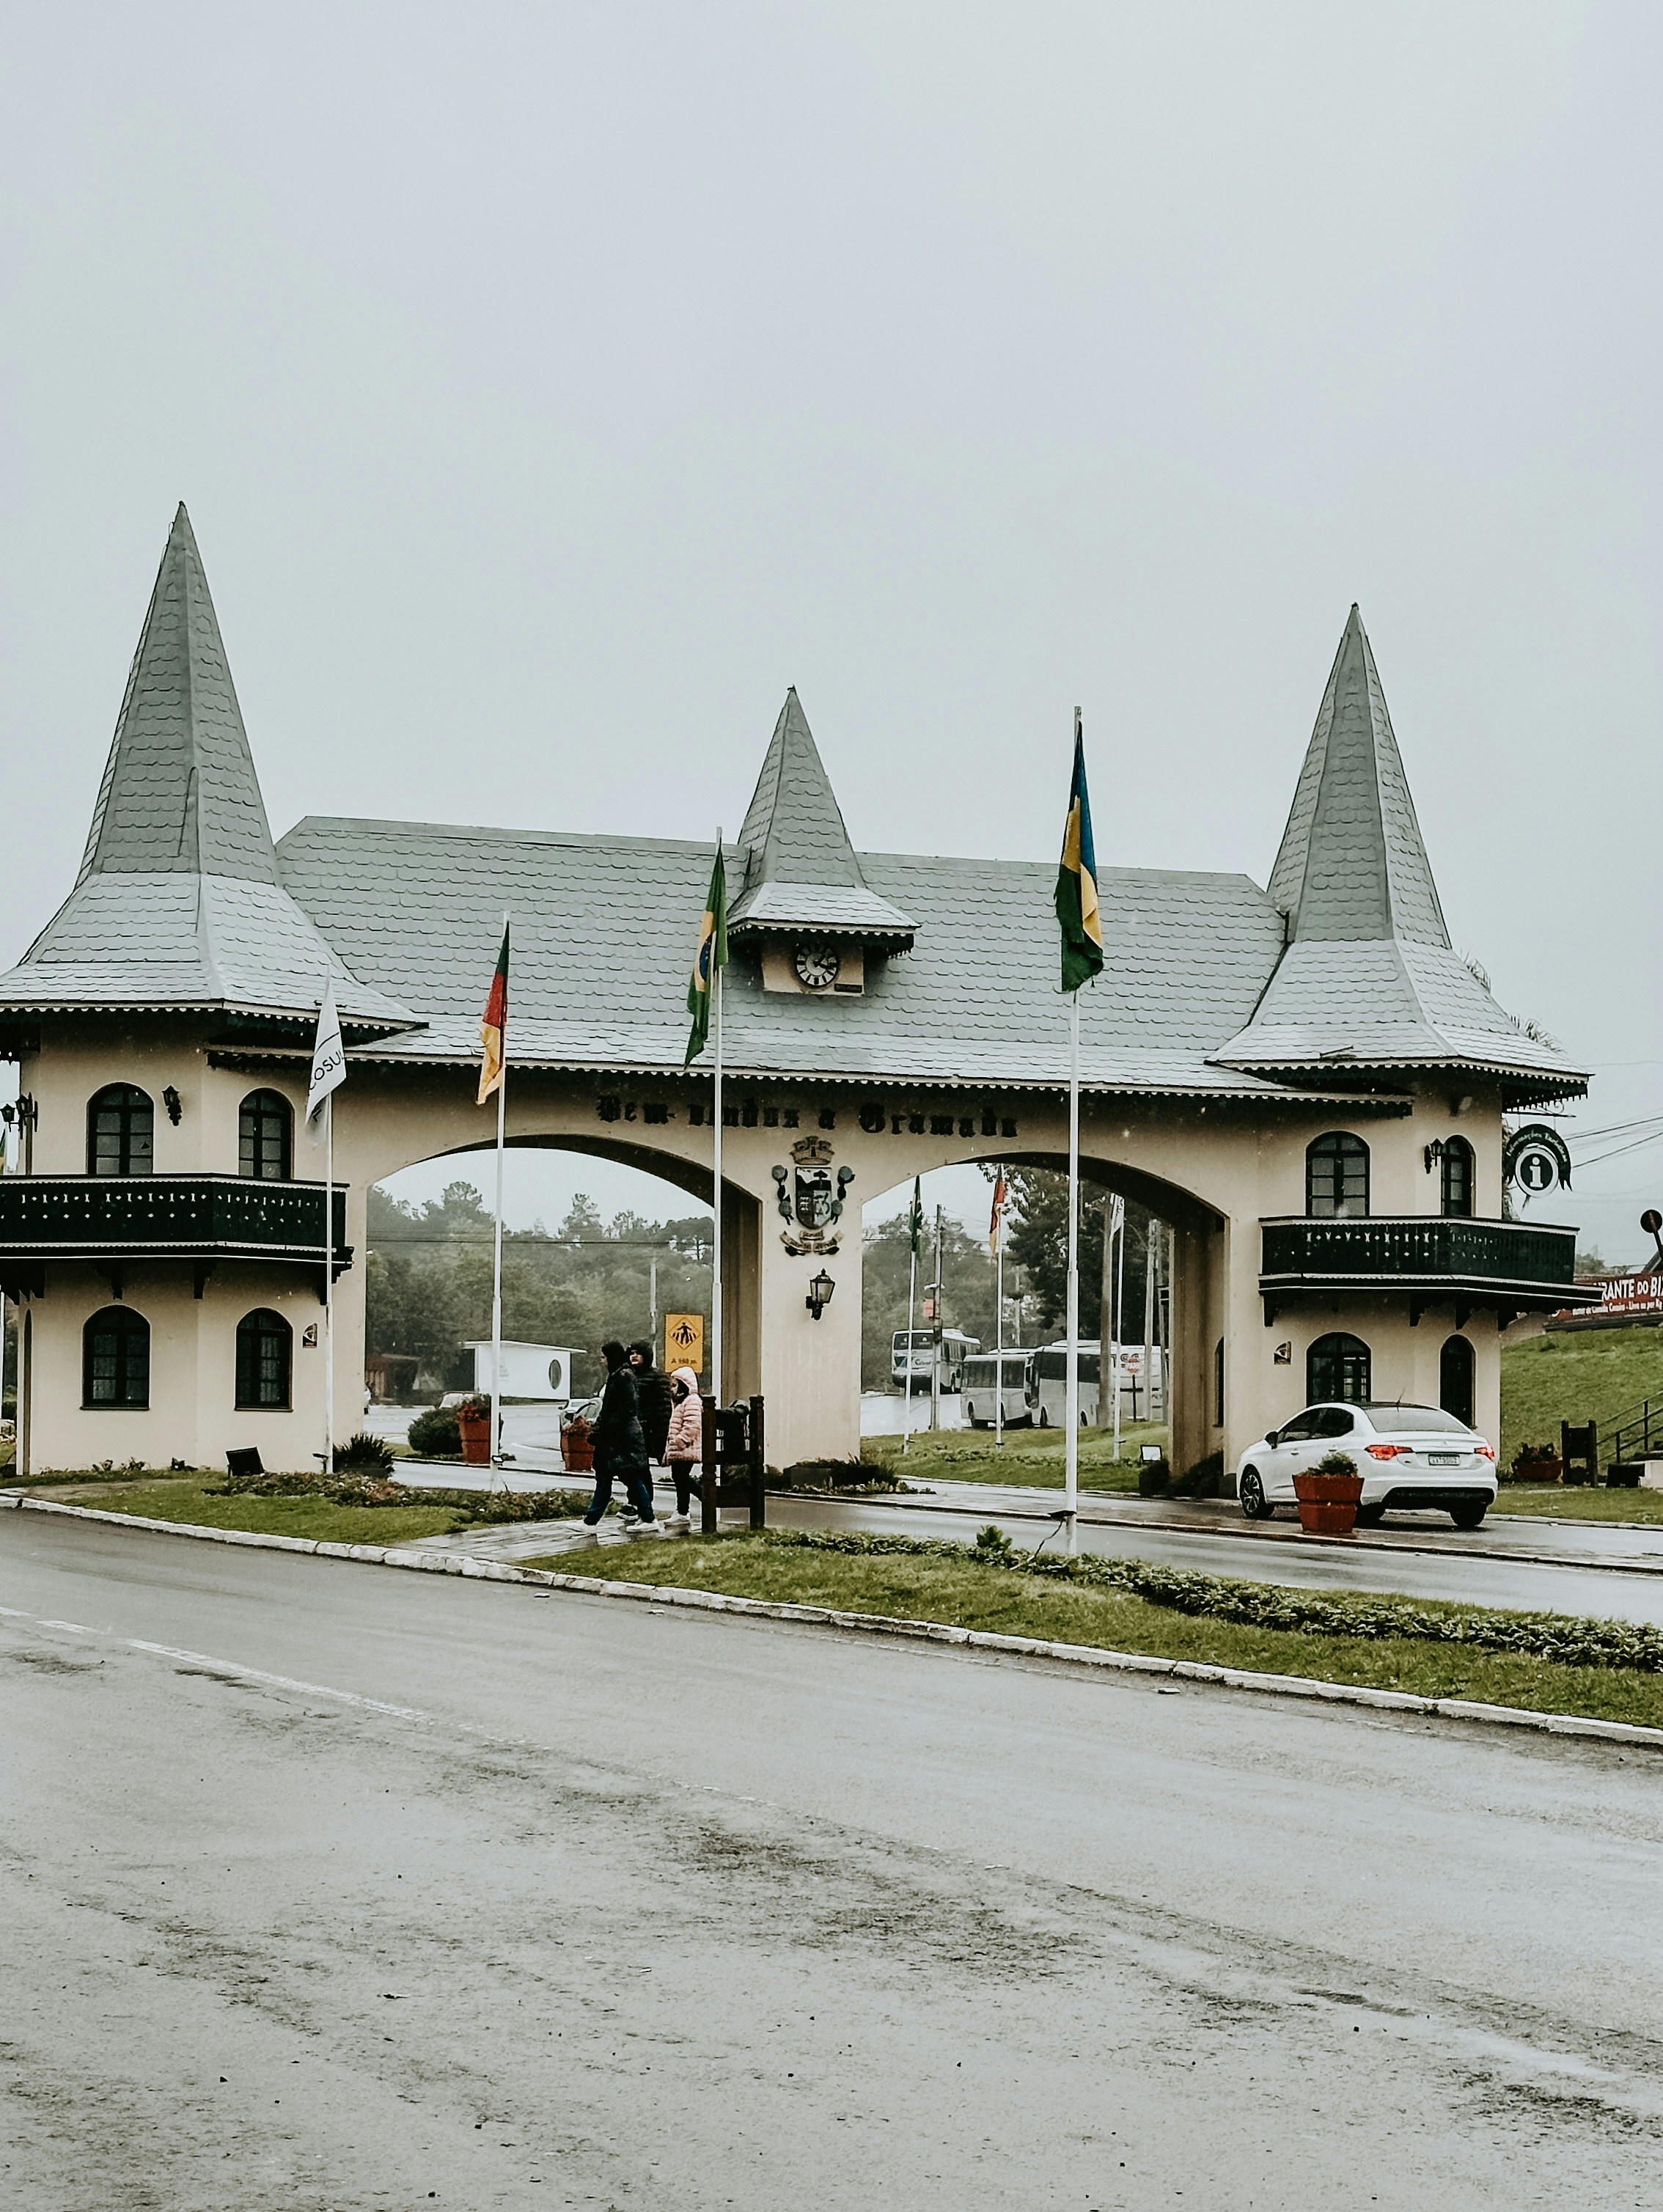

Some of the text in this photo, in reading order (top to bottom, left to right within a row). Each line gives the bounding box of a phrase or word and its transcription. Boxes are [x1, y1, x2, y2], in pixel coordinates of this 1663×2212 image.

[818, 1109, 836, 1130] a
[859, 1103, 1018, 1138] Gramado
[1637, 1280, 1649, 1295] DO
